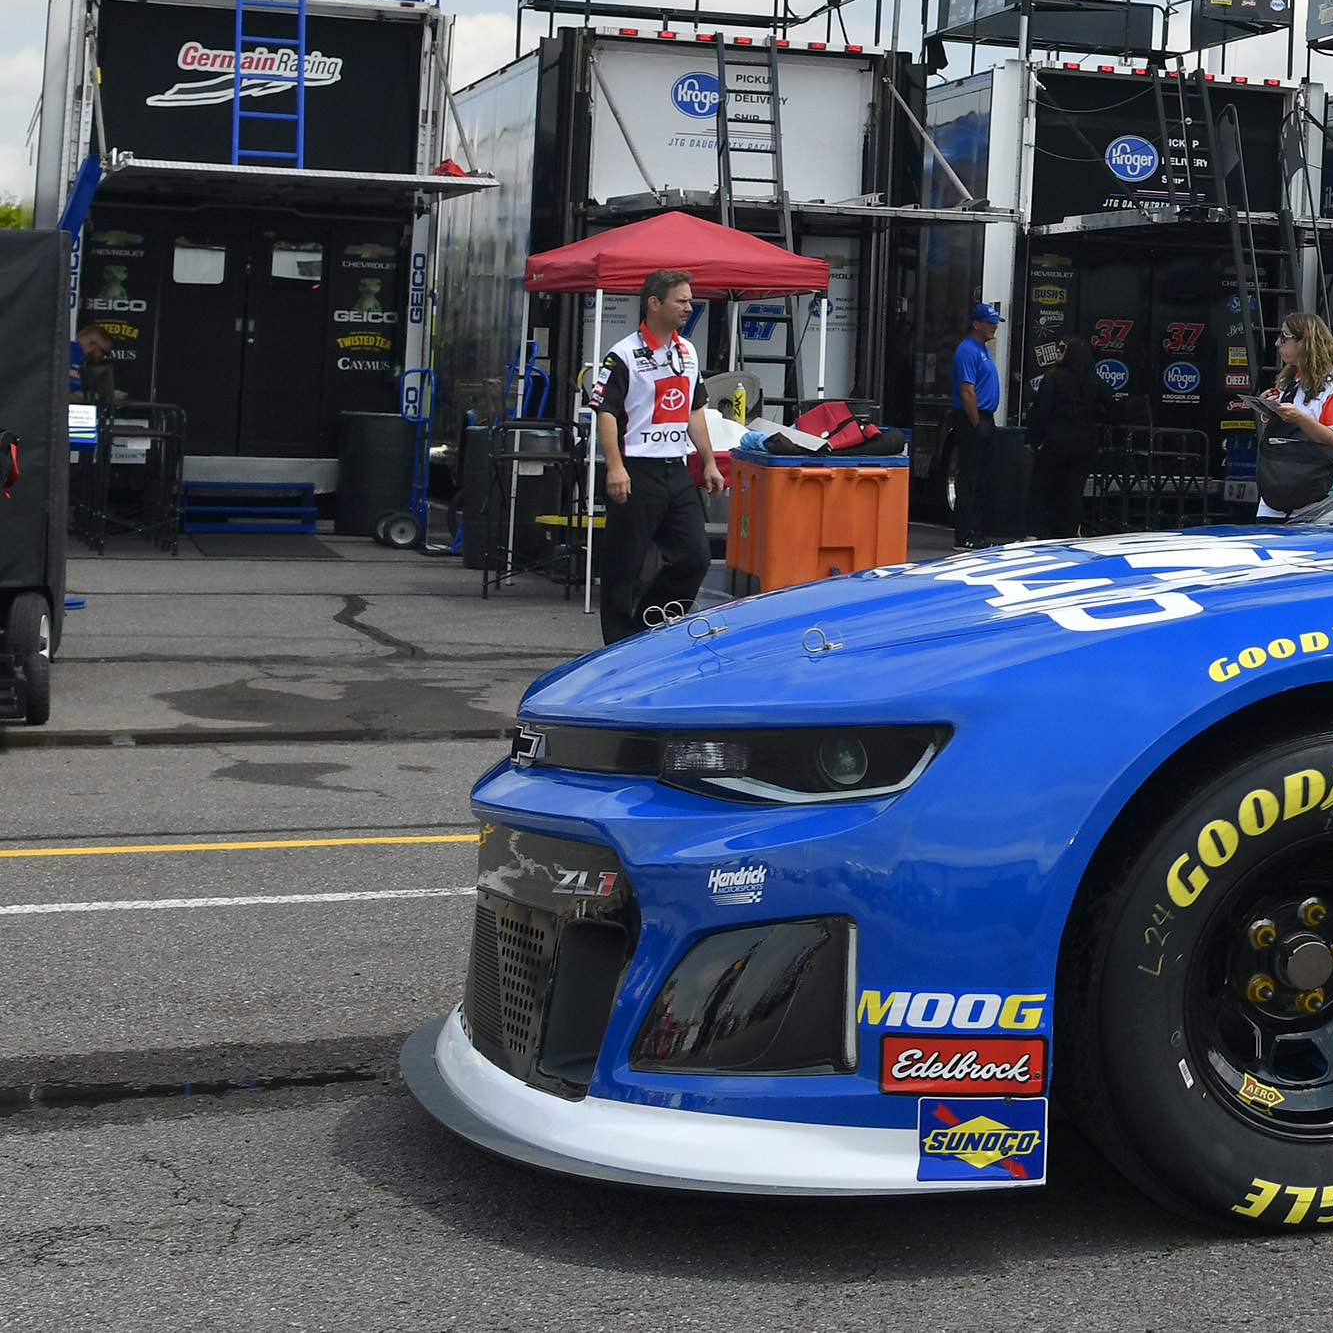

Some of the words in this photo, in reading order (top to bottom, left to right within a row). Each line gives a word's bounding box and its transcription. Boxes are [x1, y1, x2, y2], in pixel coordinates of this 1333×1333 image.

[181, 44, 276, 72] Germain
[677, 79, 720, 114] Kroge
[667, 138, 686, 147] JTG
[1112, 143, 1154, 176] Kroger
[1103, 198, 1119, 208] JTG
[410, 252, 426, 324] GEICO
[1033, 288, 1066, 301] BUSH'S
[333, 309, 398, 324] GEICO
[337, 333, 374, 350] TWISTED
[1094, 319, 1134, 349] 37
[1165, 322, 1205, 350] 37
[337, 356, 391, 371] CAYMUS
[1168, 367, 1197, 390] Kroger
[640, 430, 687, 444] TOYOT
[552, 869, 618, 896] ZL1
[708, 864, 767, 891] Hendrick
[716, 882, 764, 894] MOTORSPORTS
[856, 990, 1047, 1029] MOOG
[891, 1048, 1031, 1083] Edelbrock
[1243, 1081, 1277, 1103] AERO
[926, 1128, 1038, 1154] SUNOCO
